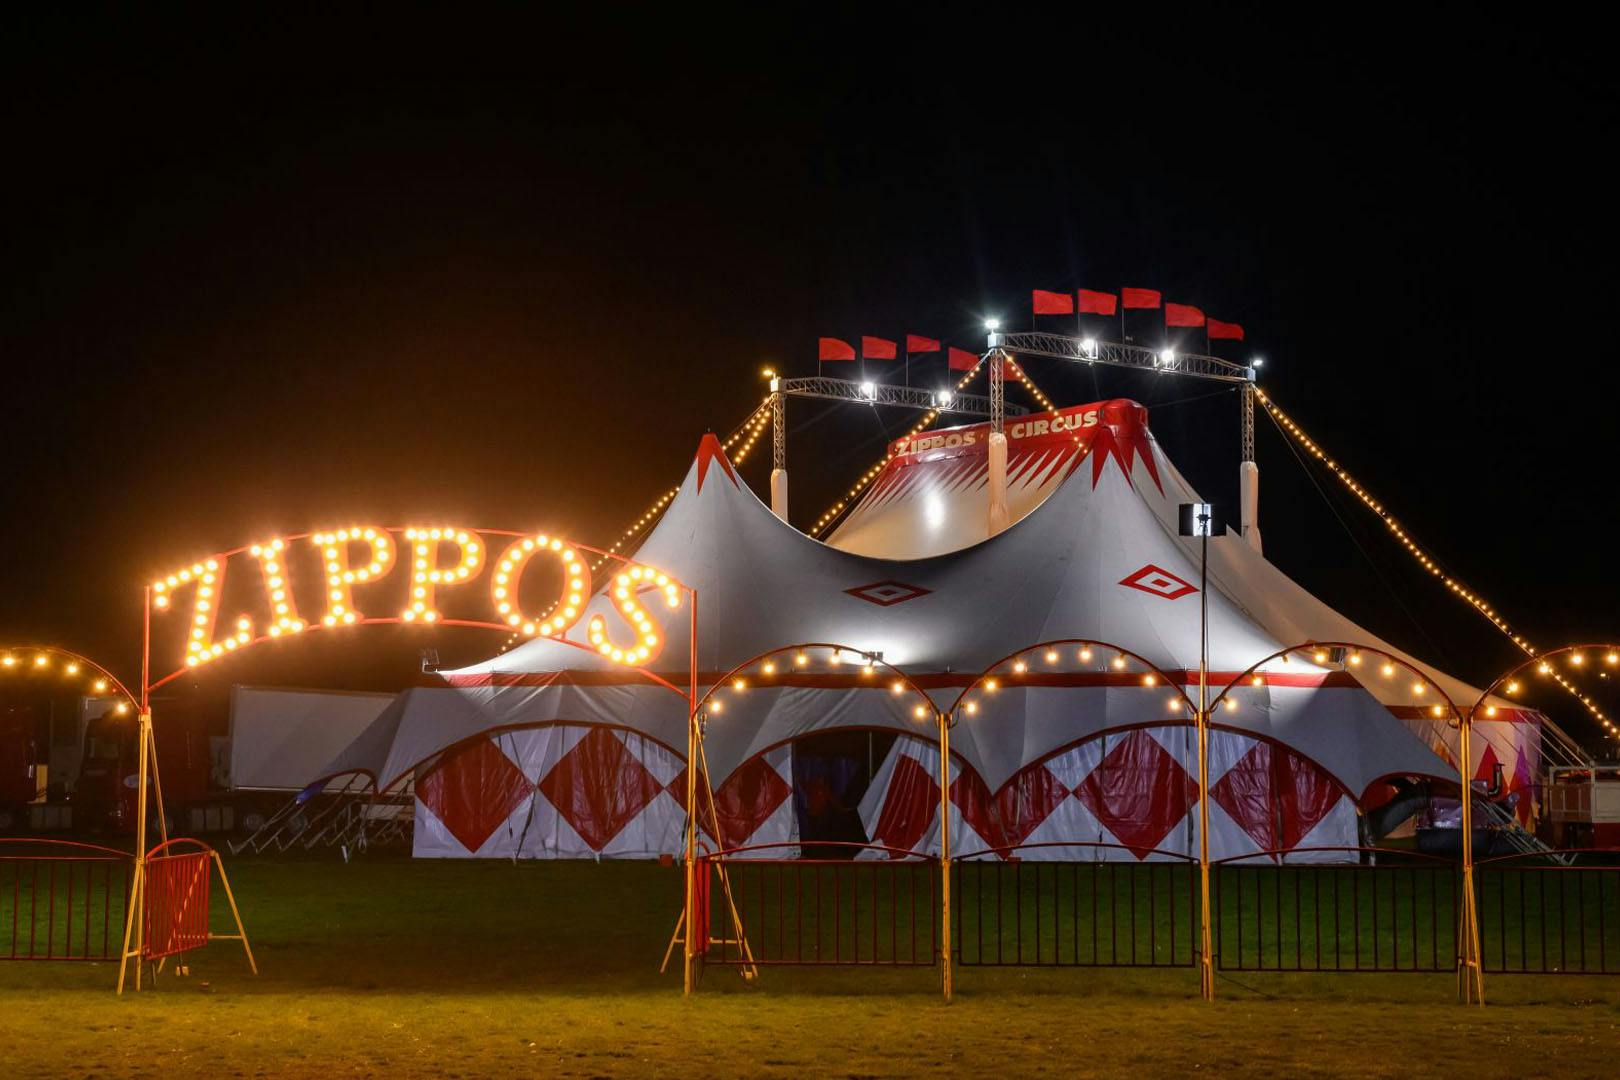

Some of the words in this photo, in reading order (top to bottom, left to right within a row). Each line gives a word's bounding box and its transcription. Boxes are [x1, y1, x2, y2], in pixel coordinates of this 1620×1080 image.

[896, 431, 976, 456] ZIPPOS
[1011, 410, 1098, 439] CIRCUS
[152, 526, 684, 668] ZIPPOS
